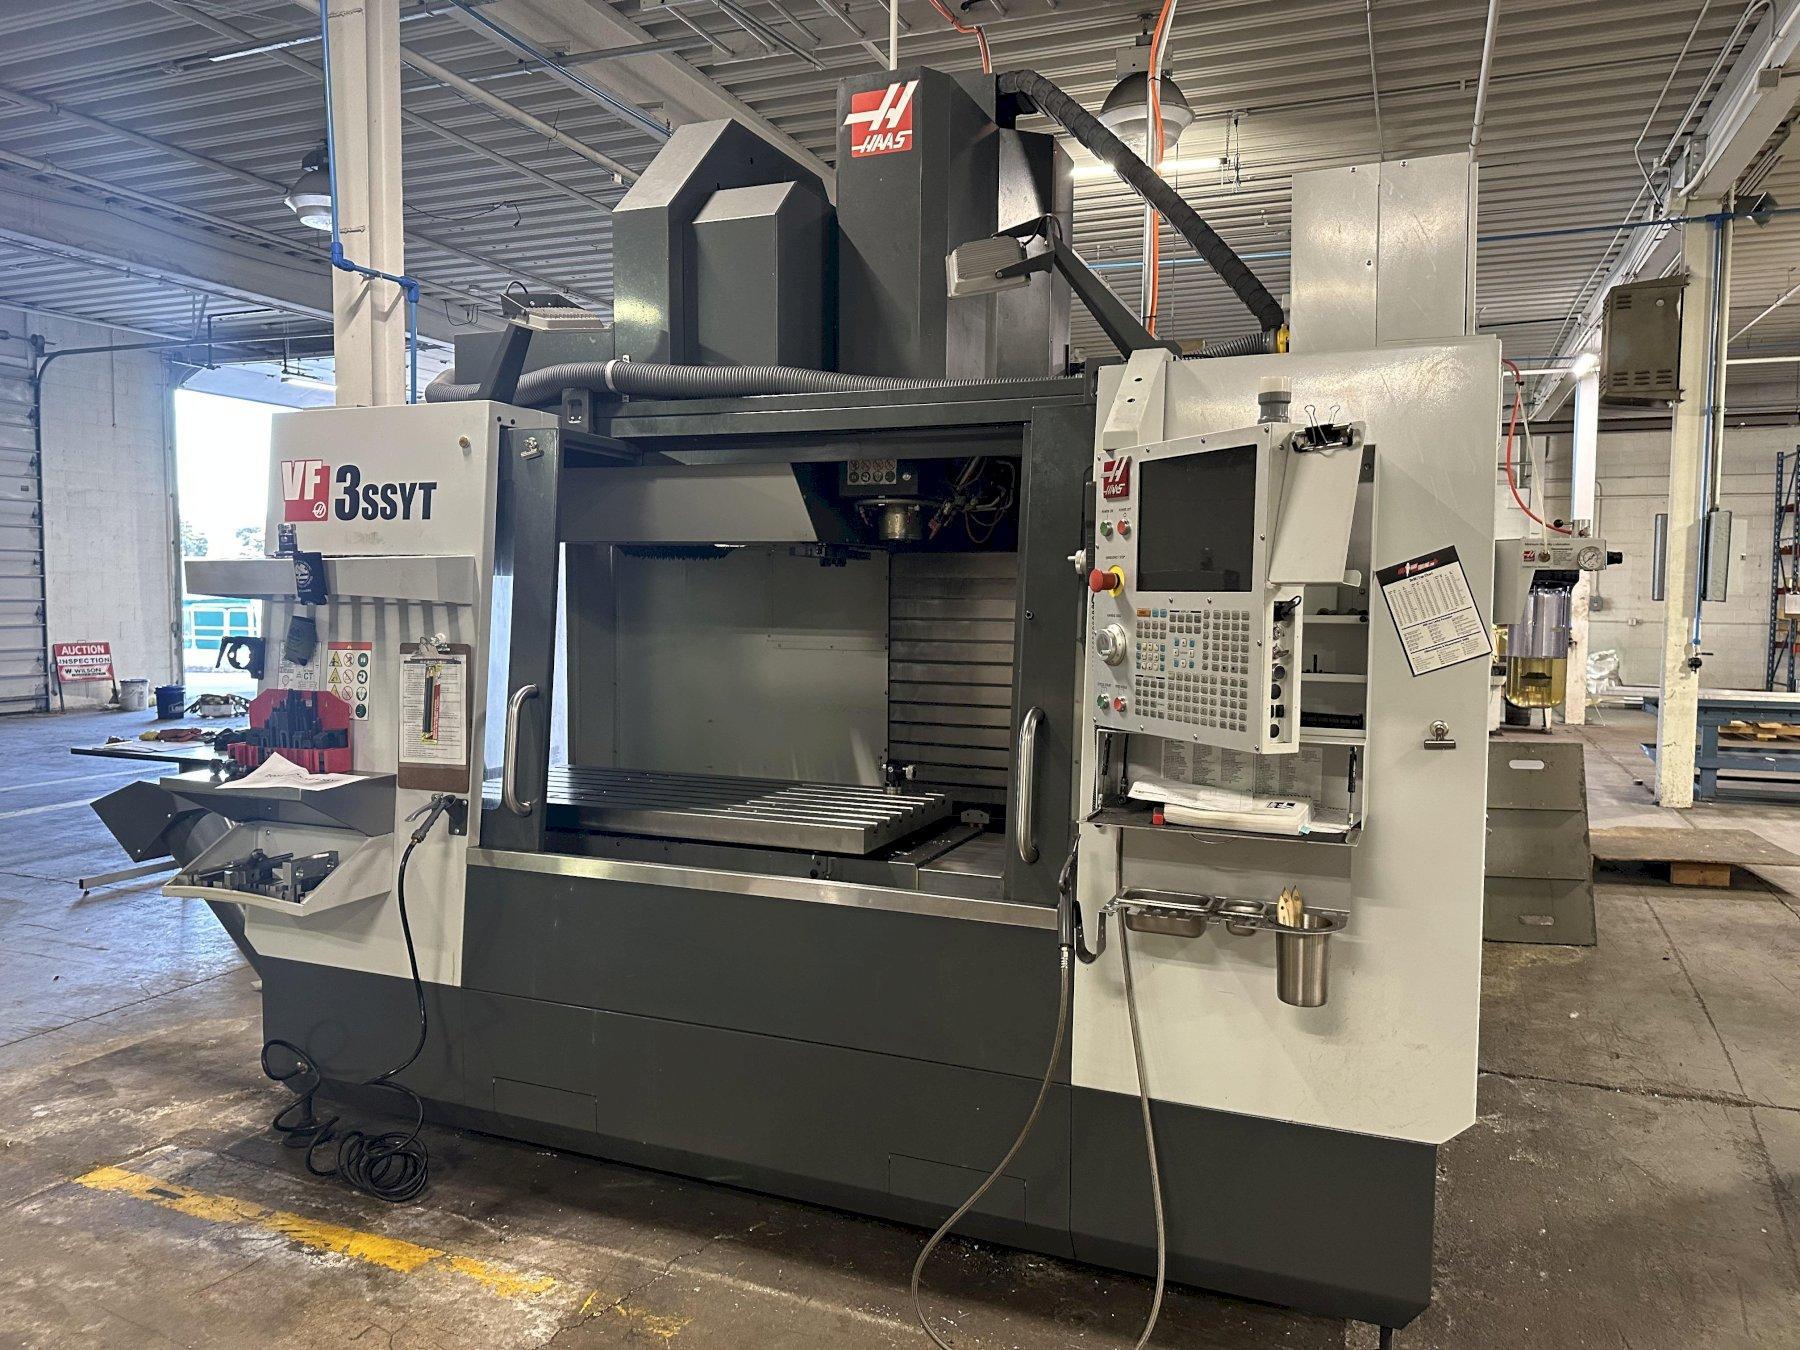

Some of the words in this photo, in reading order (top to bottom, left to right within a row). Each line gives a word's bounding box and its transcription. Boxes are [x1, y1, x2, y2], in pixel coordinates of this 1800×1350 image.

[852, 130, 912, 153] HAAS
[281, 460, 323, 500] VF
[335, 464, 437, 521] 3SSYT
[61, 645, 105, 655] AUCTION
